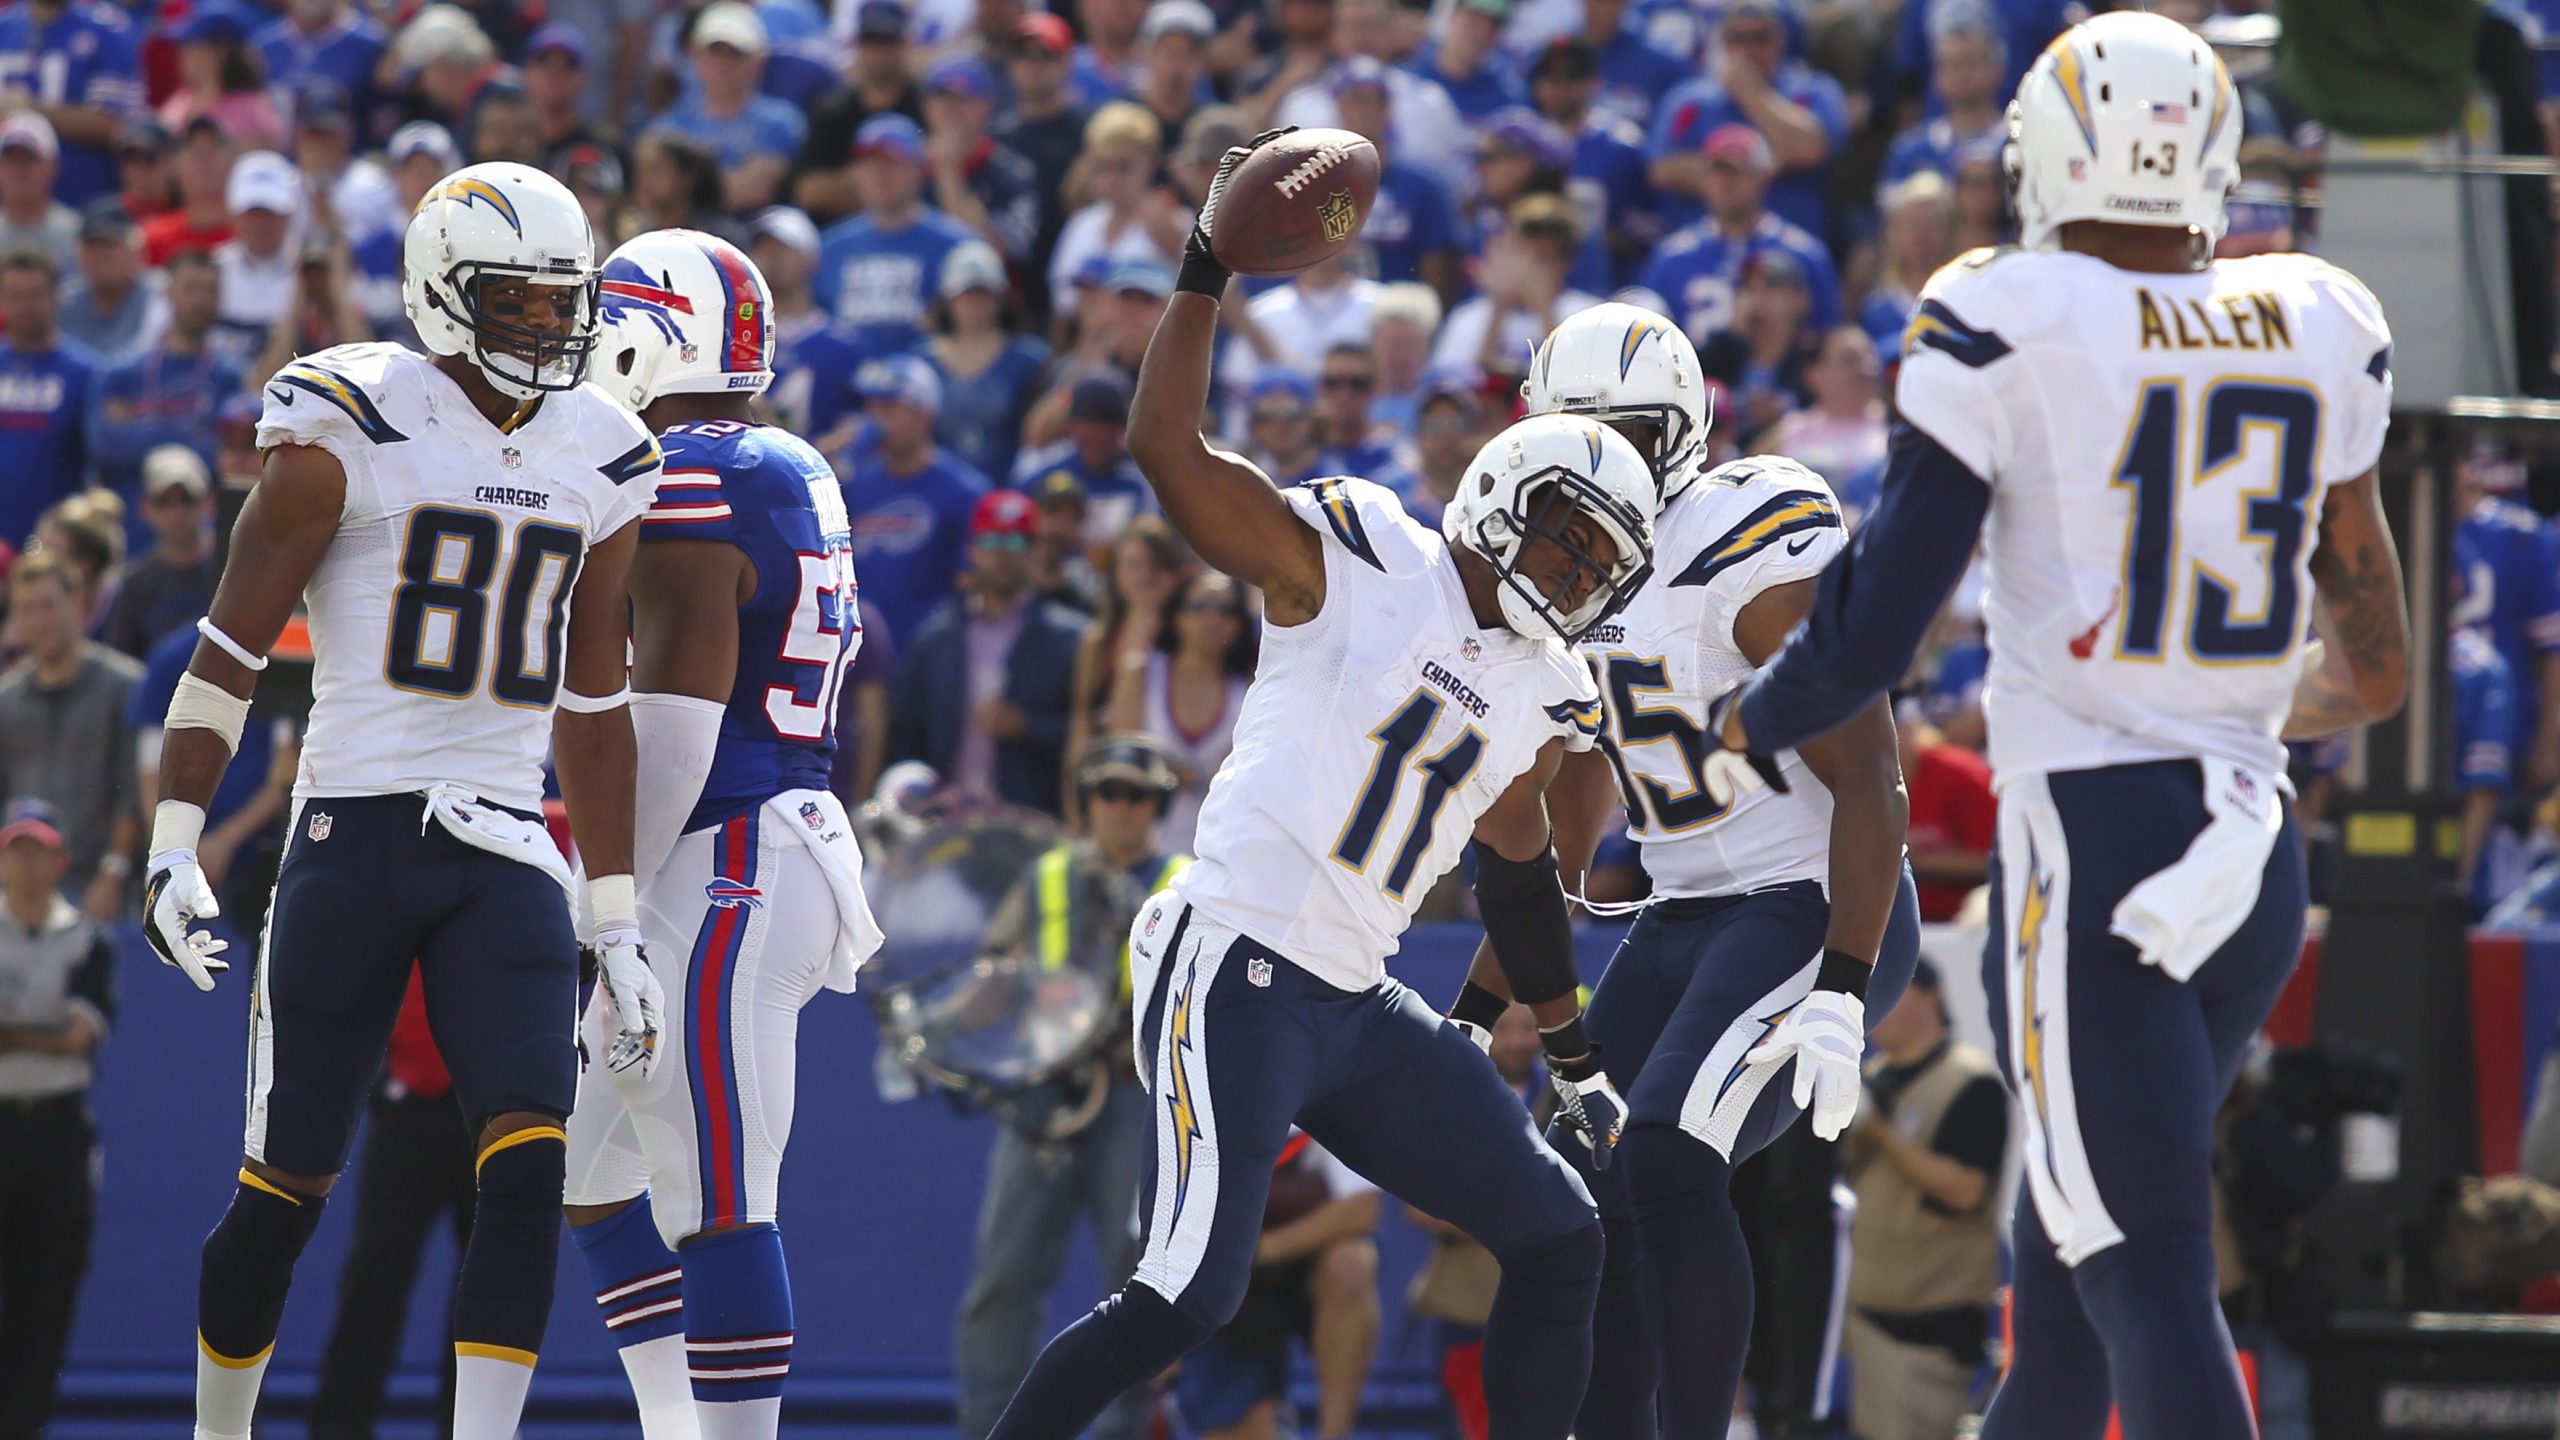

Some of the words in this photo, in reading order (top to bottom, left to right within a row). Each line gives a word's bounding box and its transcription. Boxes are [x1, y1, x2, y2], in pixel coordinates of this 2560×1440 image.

[2136, 287, 2293, 350] ALLEN
[727, 376, 766, 389] BILLS
[475, 485, 550, 510] CHARGERS
[2109, 374, 2328, 668] 13
[383, 503, 585, 712] 80
[1421, 660, 1491, 719] CHARGERS
[1328, 685, 1490, 904] 11
